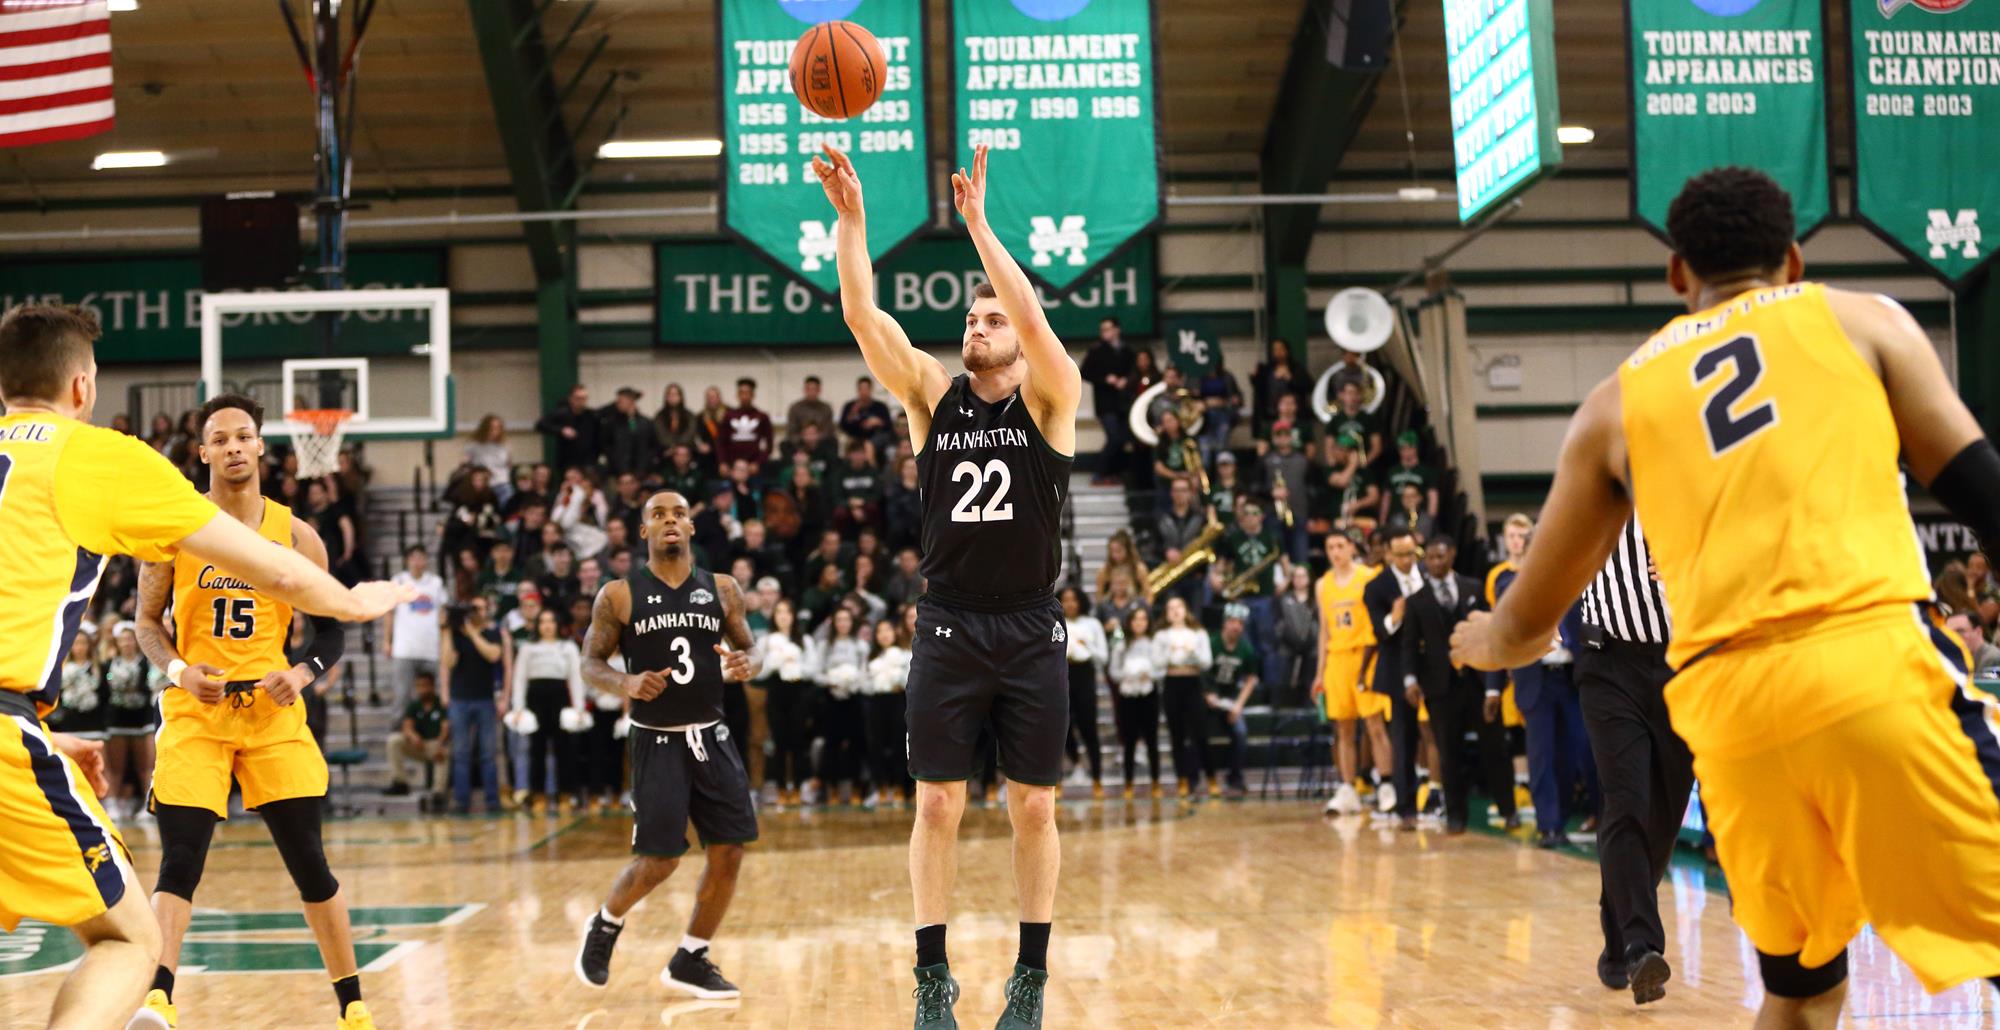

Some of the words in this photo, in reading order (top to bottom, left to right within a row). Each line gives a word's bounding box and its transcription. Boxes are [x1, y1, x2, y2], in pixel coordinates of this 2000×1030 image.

[965, 34, 1139, 61] TOURNAMENT
[1643, 31, 1811, 56] TOURNAMENT
[966, 62, 1141, 90] APPEARANCES
[1645, 59, 1814, 84] APPEARANCES
[738, 103, 787, 125] 1956
[969, 98, 1018, 120] 1987
[1030, 97, 1079, 119] 1990
[1092, 96, 1140, 118] 1996
[1647, 93, 1697, 115] 2002
[1706, 92, 1756, 114] 2003
[1866, 94, 1914, 116] 2002
[1923, 94, 1972, 116] 2003
[739, 133, 788, 154] 1995
[798, 131, 852, 154] 2003
[860, 130, 913, 152] 2004
[968, 128, 1021, 150] 2003
[739, 163, 788, 184] 2014
[674, 274, 773, 313] THE
[1691, 334, 1777, 456] 2
[936, 427, 1029, 451] MANHATTAN
[951, 459, 1013, 522] 22
[212, 597, 255, 640] 15
[634, 612, 720, 636] MANHATTAN
[1335, 610, 1353, 629] 14
[670, 636, 695, 685] 3
